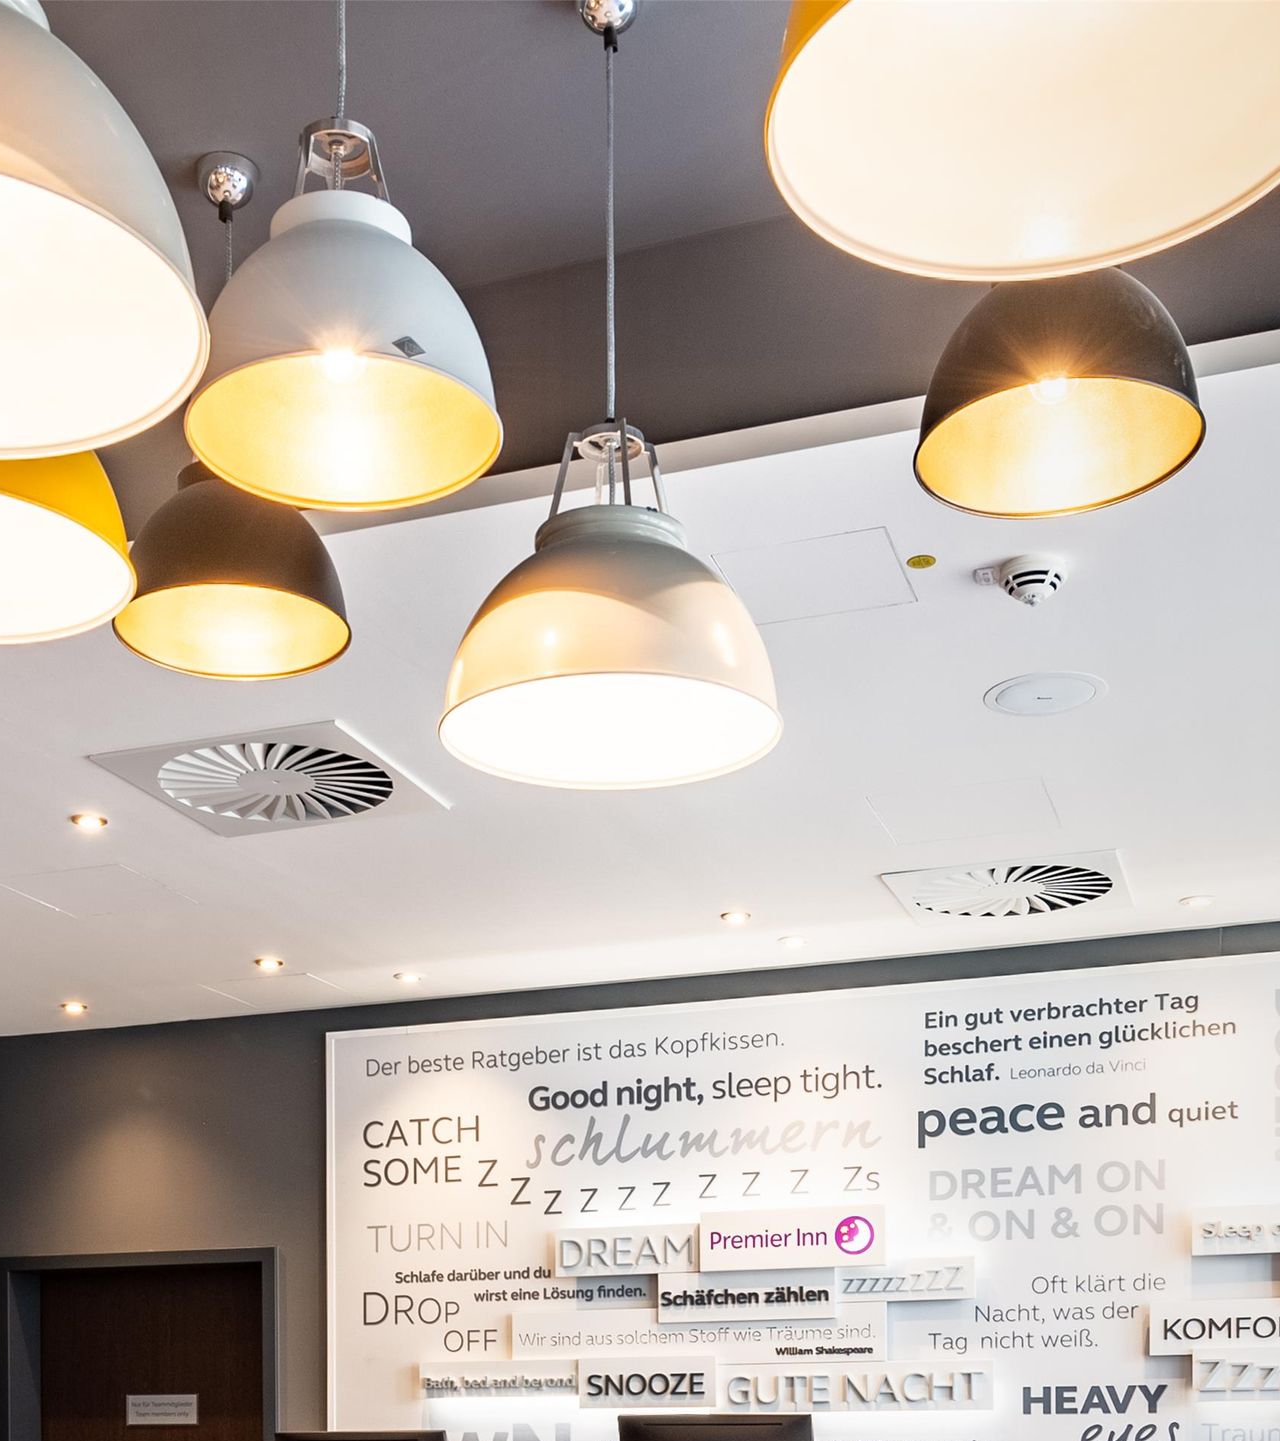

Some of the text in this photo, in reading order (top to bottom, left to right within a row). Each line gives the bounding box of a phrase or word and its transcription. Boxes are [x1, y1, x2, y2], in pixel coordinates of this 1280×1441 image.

[924, 993, 1199, 1031] Ein gut verbrachter Tag
[924, 1019, 1236, 1057] beschert einen glücklichen
[365, 1032, 784, 1077] Der beste Ratgeber ist das Kopfkissen.
[924, 1058, 1147, 1085] Schlaf. Leonardo da Vinci
[528, 1064, 882, 1111] Good night, sleep tight.
[362, 1115, 480, 1148] CATCH
[918, 1092, 1239, 1149] peace and quiet
[526, 1114, 882, 1169] schlummern
[363, 1155, 462, 1188] SOME
[929, 1159, 1166, 1201] DREAM ON
[367, 1220, 508, 1253] TURN IN
[968, 1208, 1035, 1242] ON
[1050, 1206, 1080, 1238] &
[1094, 1203, 1164, 1237] ON
[1202, 1221, 1265, 1240] Sleep
[559, 1233, 694, 1269] DREAM
[709, 1228, 827, 1250] Premier Inn
[394, 1266, 551, 1284] Schlafe darüber und du
[1031, 1273, 1166, 1294] Oft klärt die
[363, 1291, 460, 1325] DROP
[473, 1284, 647, 1302] wirst eine Lösung finden.
[661, 1286, 830, 1307] Schäfchen zählen
[975, 1301, 1139, 1324] Nacht, was der
[443, 1329, 497, 1352] OFF
[519, 1324, 876, 1347] Wir sind aus solchem Stoff wie Träume sind.
[775, 1346, 873, 1356] William Shakespeare
[928, 1328, 1098, 1354] Tag nicht weiß.
[462, 1376, 488, 1389] bed
[492, 1376, 518, 1389] and
[521, 1375, 576, 1390] beyond
[587, 1373, 705, 1396] SNOOZE
[727, 1371, 984, 1405] GUTE NACHT
[1022, 1384, 1168, 1415] HEAVY
